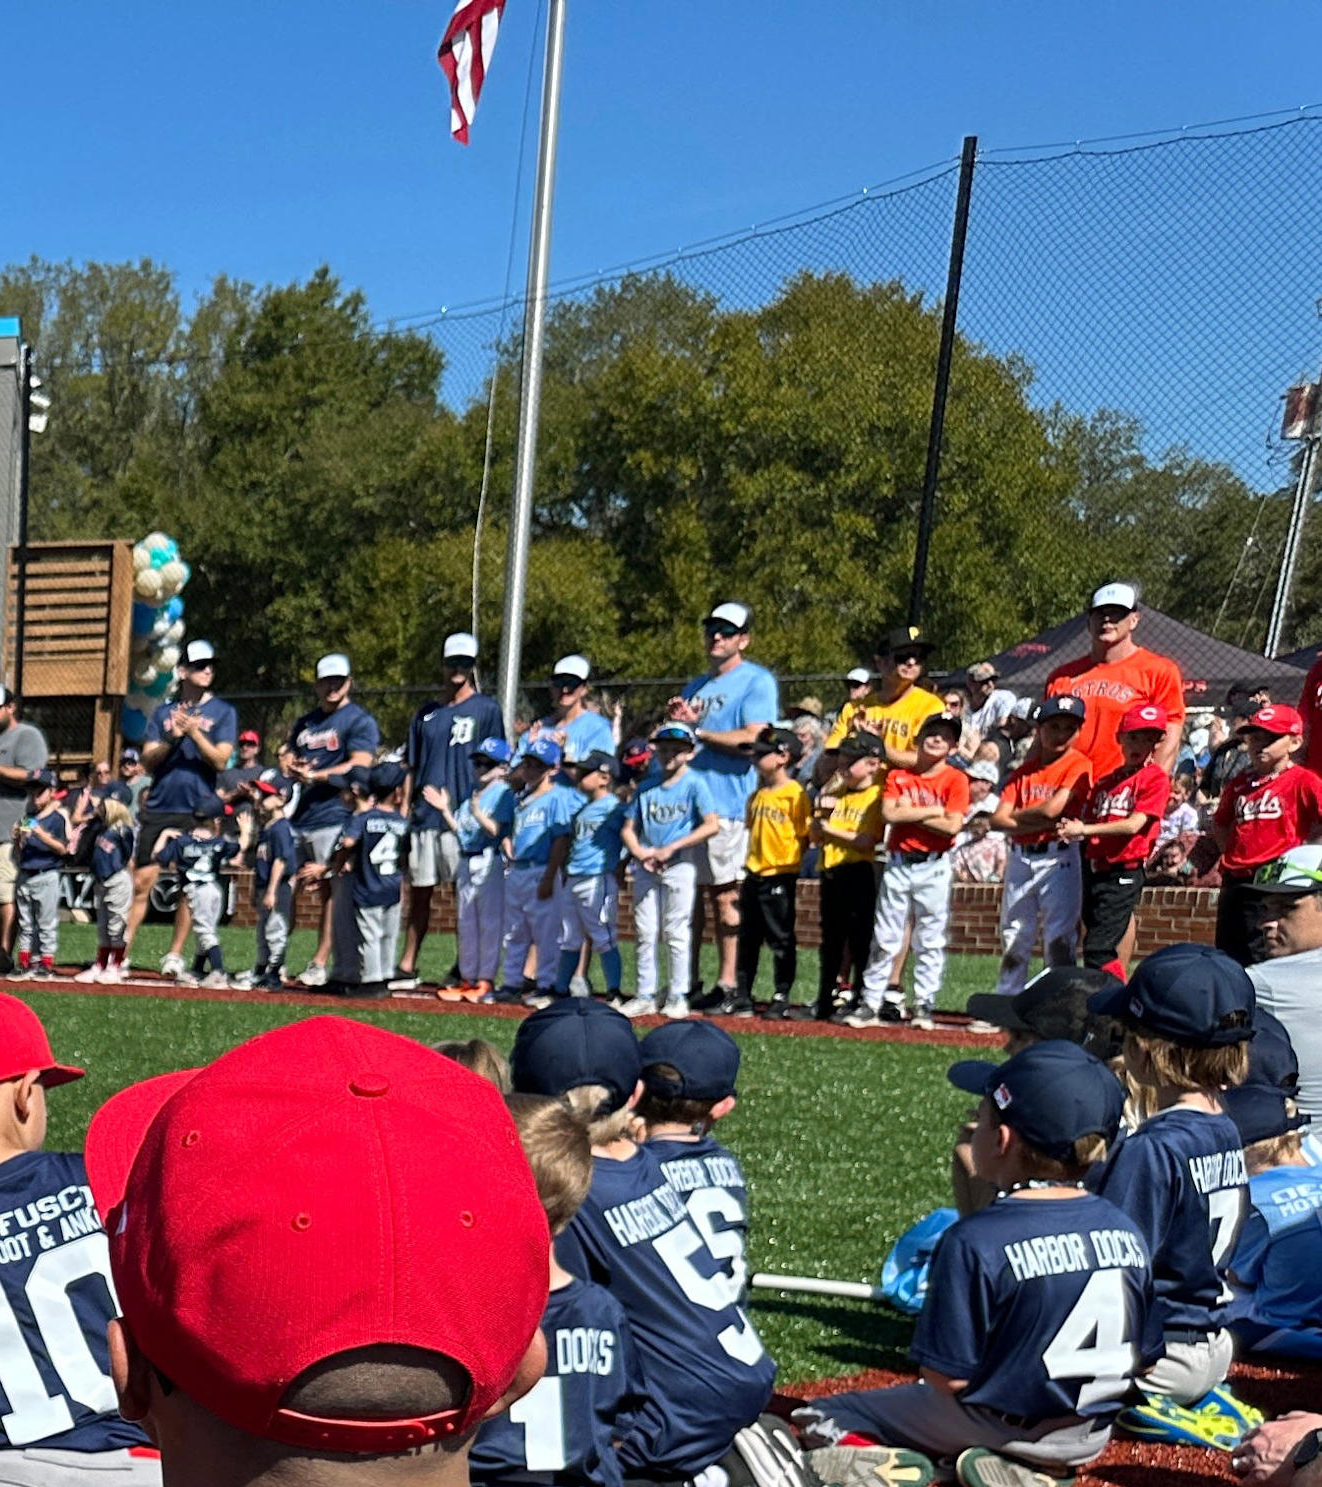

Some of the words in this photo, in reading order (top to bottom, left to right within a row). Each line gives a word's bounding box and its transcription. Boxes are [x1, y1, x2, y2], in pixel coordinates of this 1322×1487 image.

[449, 715, 475, 747] D
[37, 1225, 56, 1250] &
[1004, 1232, 1089, 1282] HARBOR
[1090, 1229, 1145, 1269] DOCKS
[1042, 1268, 1134, 1414] 4
[510, 1375, 567, 1471] 1
